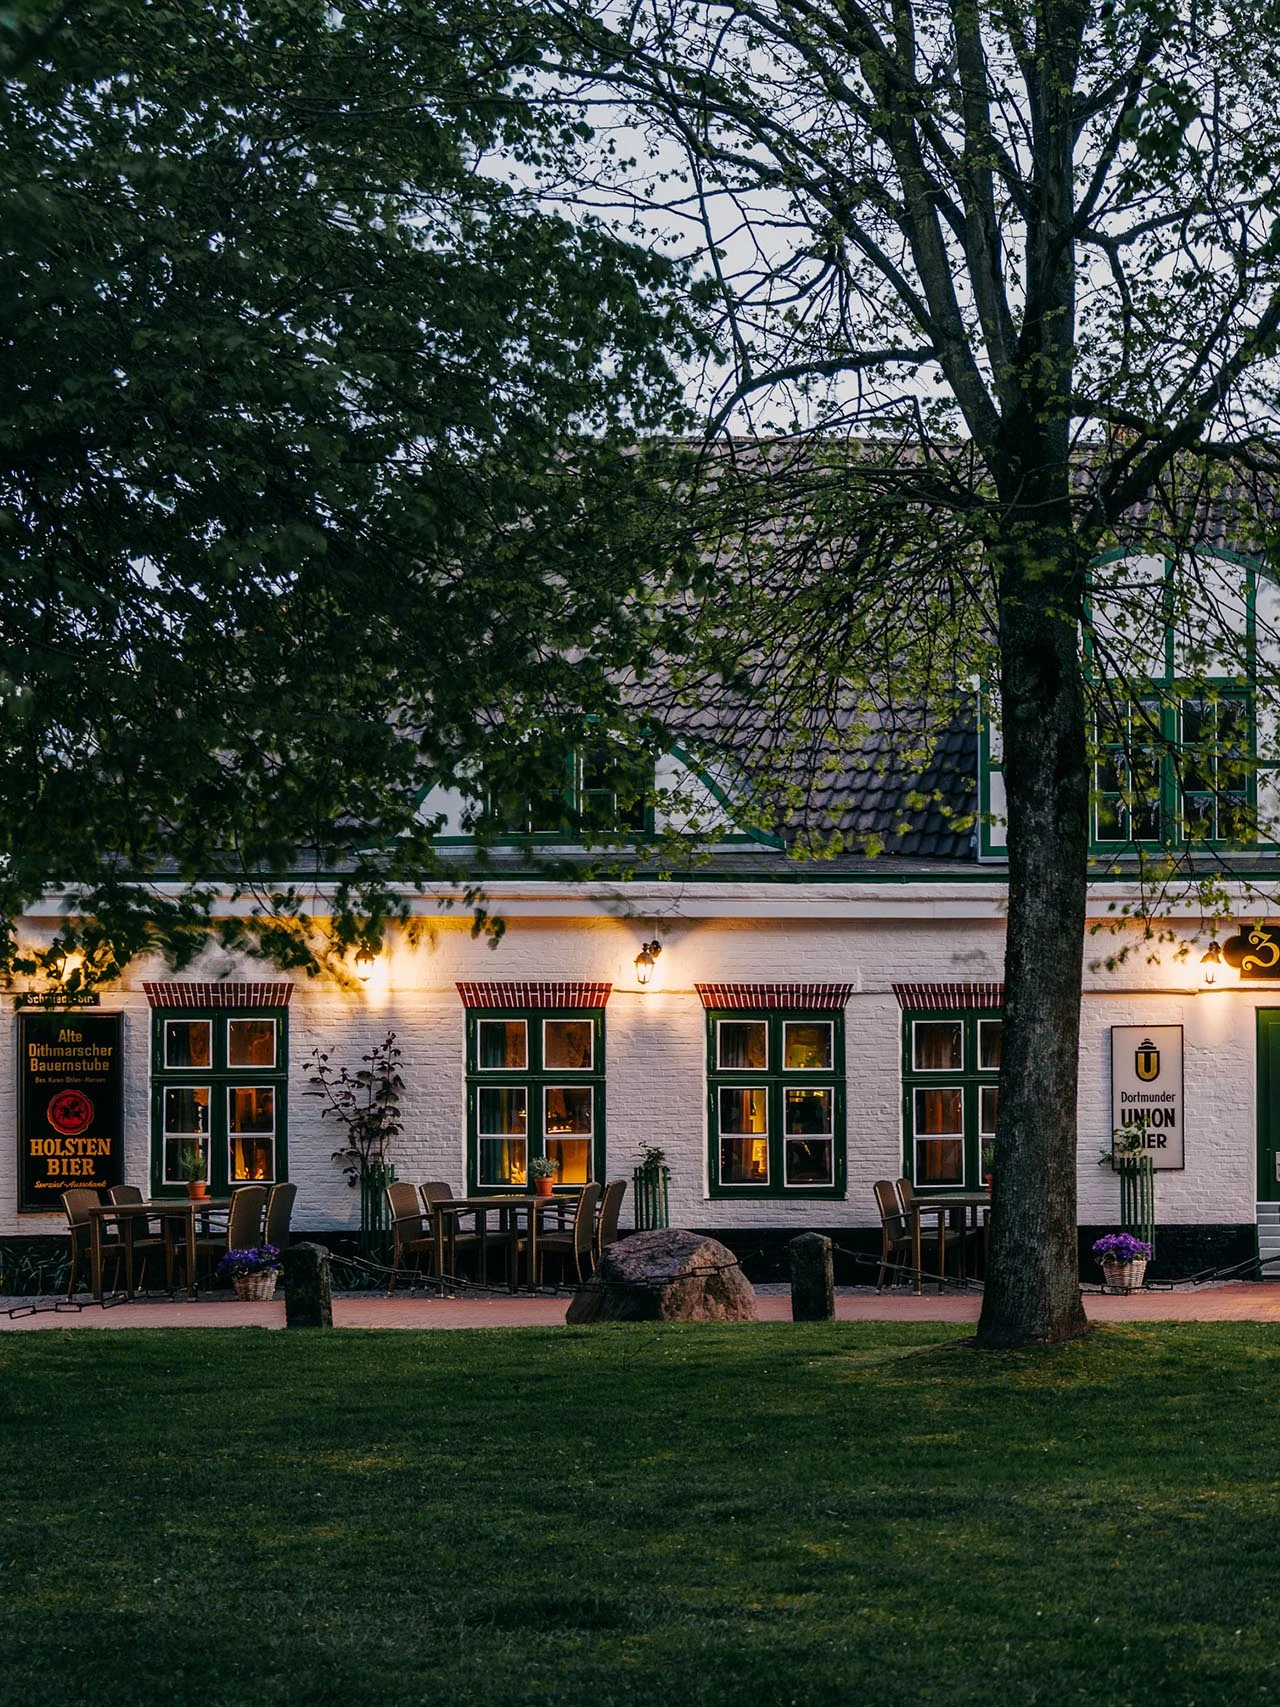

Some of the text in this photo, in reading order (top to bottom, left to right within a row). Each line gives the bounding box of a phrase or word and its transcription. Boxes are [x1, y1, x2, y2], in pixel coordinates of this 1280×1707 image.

[27, 993, 95, 1004] Schied-Str.
[58, 1029, 83, 1043] Alte
[28, 1043, 113, 1057] Dithmarscher
[30, 1058, 110, 1072] Bauernstube
[1121, 1091, 1176, 1103] Dortmunder
[1121, 1108, 1176, 1128] UNION
[30, 1138, 111, 1156] HOLSTEN
[47, 1158, 95, 1176] BIER
